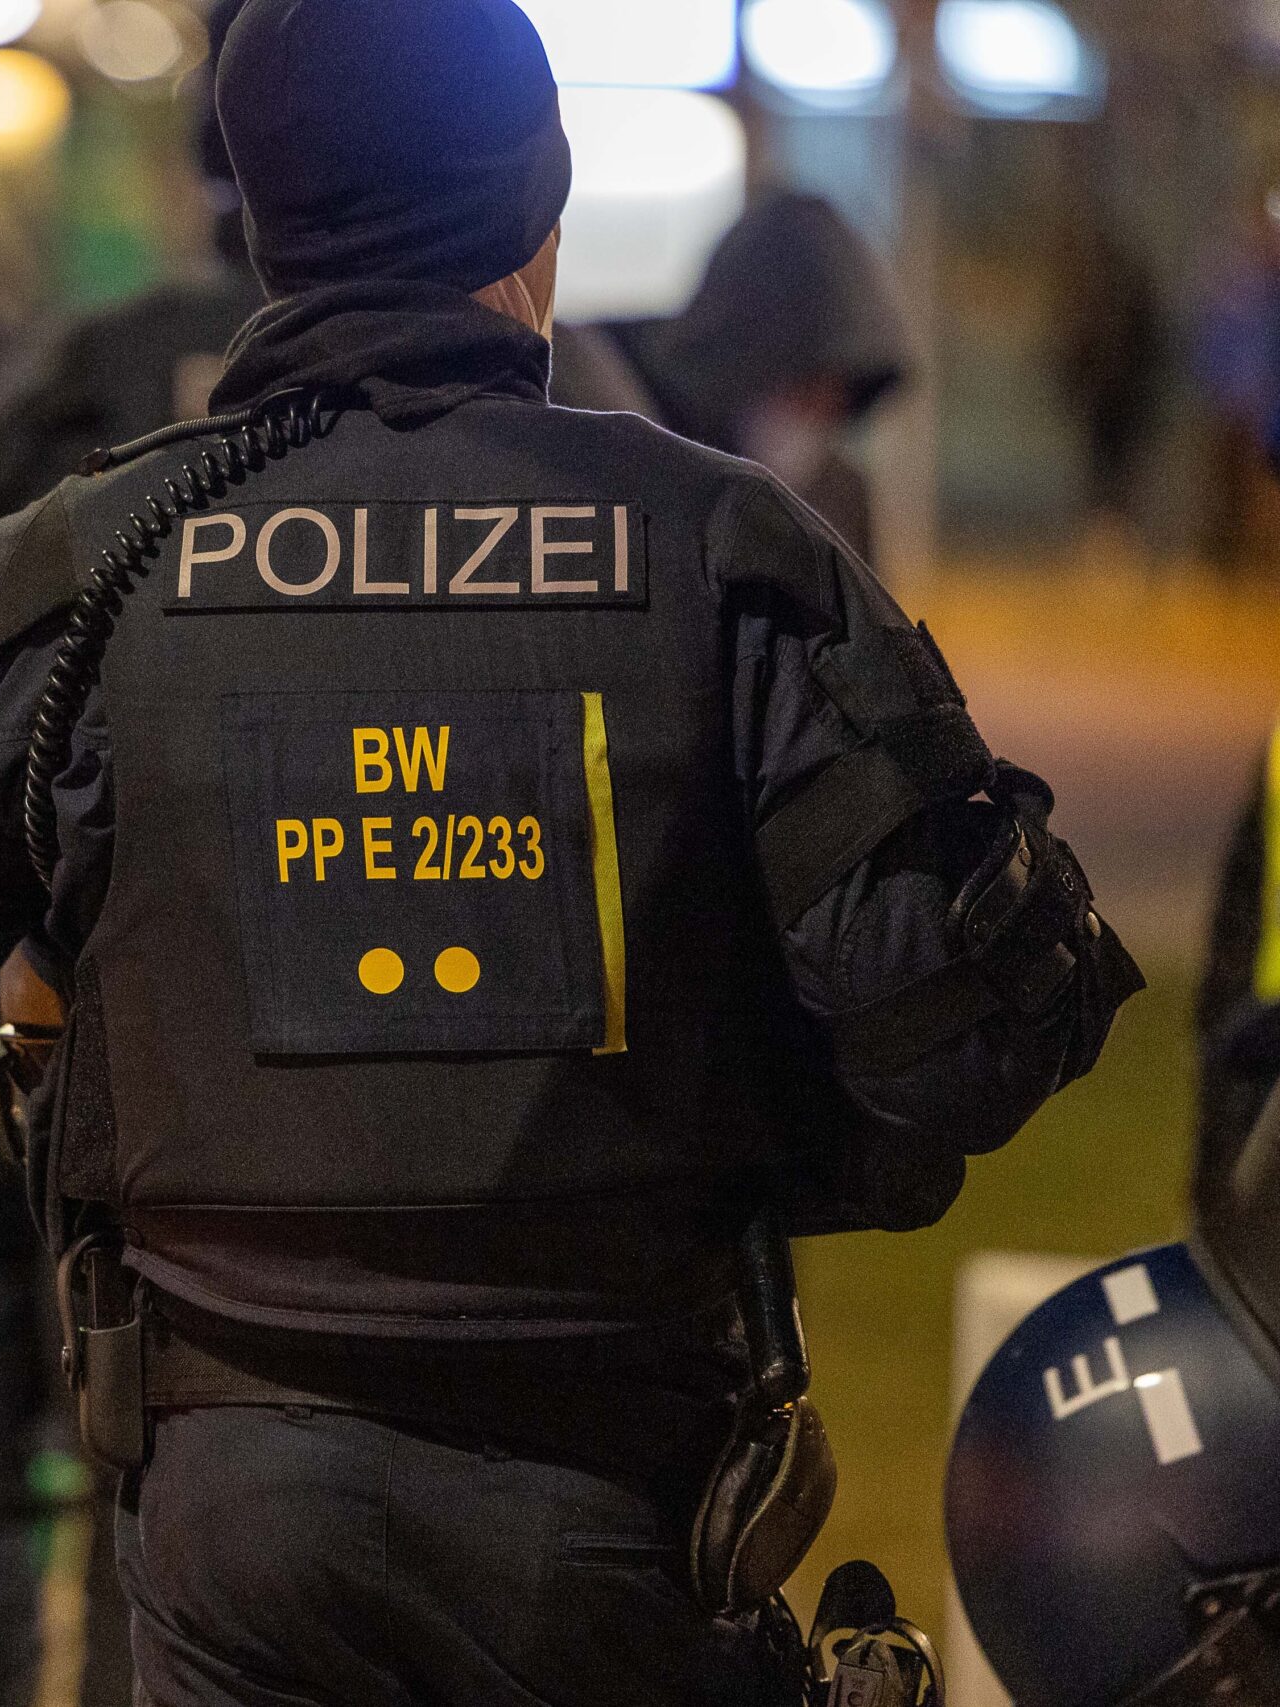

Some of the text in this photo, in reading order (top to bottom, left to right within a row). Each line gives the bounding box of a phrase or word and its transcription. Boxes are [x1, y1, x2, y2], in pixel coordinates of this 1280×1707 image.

[177, 505, 628, 598] POLIZEI
[352, 725, 451, 794] BW
[275, 814, 545, 884] PP E 2/233
